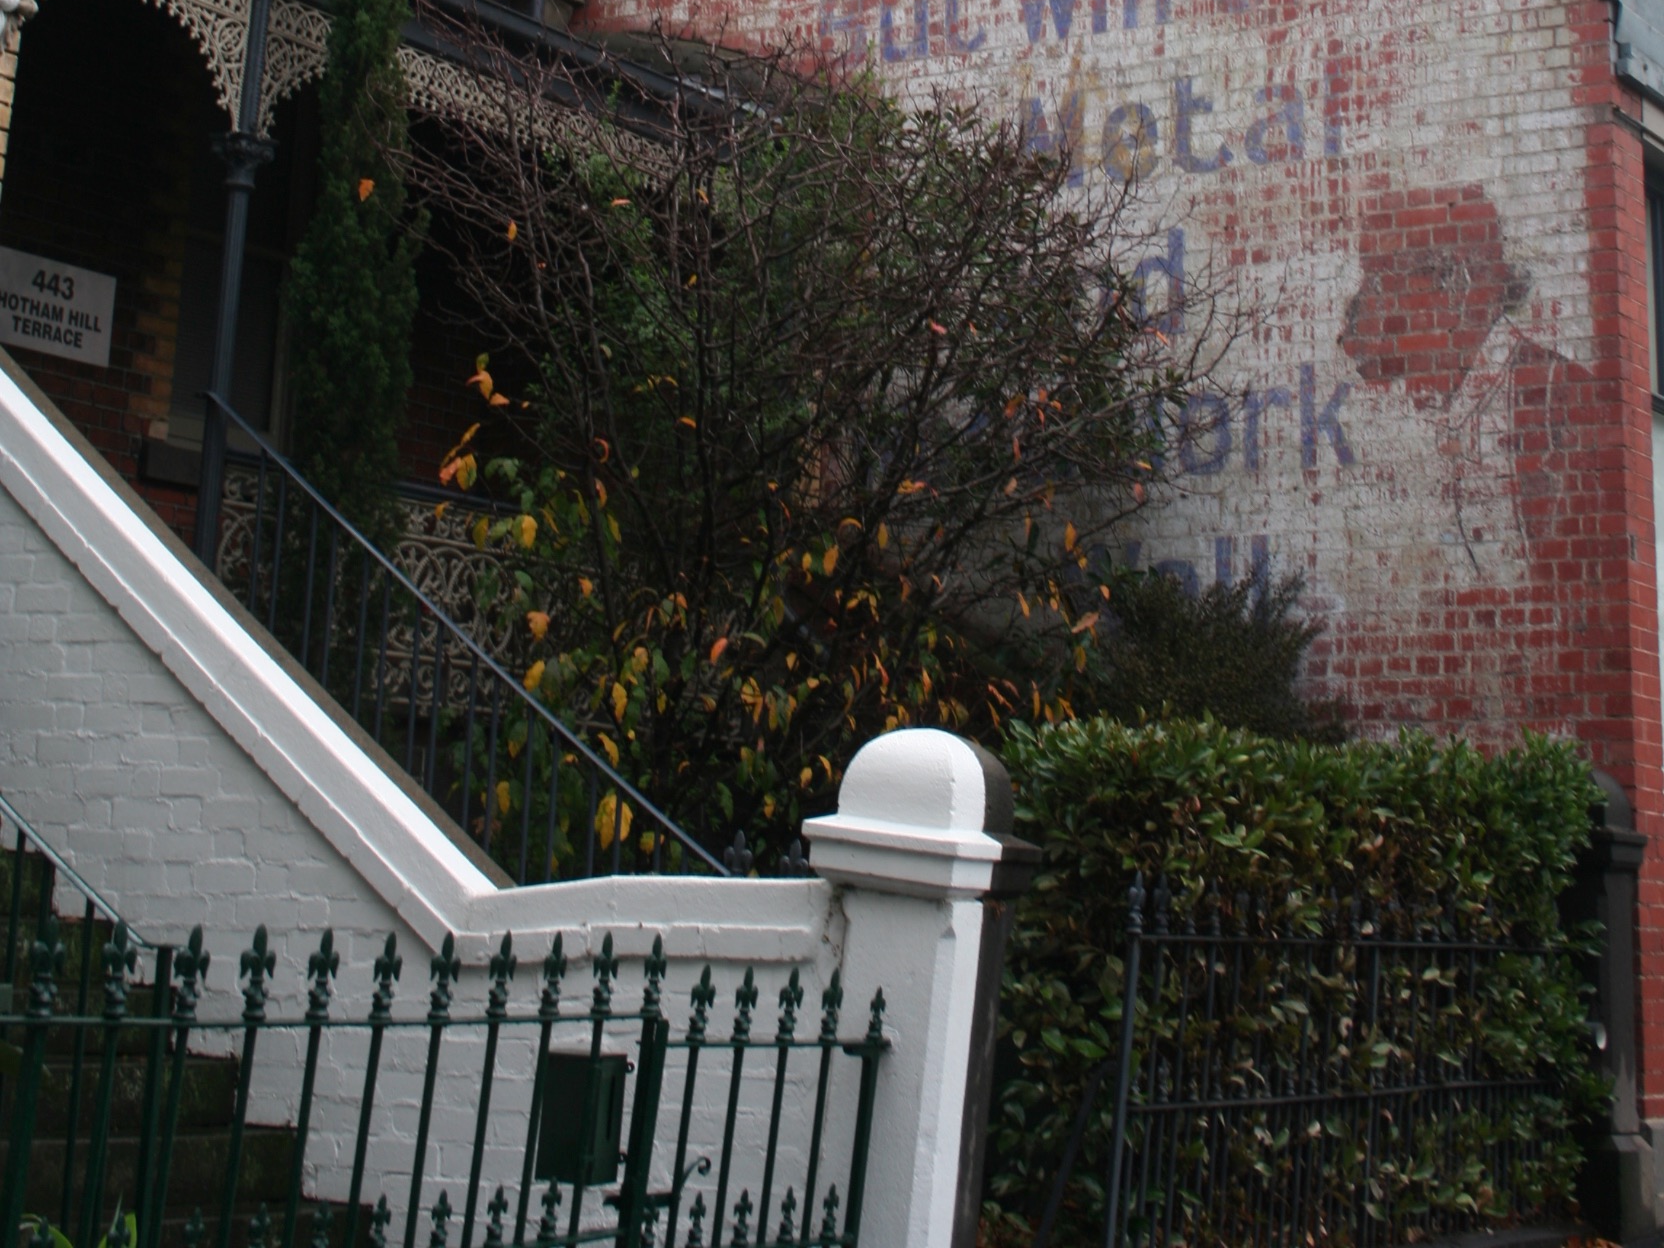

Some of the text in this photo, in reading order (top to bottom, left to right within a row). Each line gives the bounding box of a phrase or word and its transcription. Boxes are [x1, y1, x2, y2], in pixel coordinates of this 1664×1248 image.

[32, 269, 75, 301] 443
[0, 288, 102, 334] HOTHAM HILL
[12, 314, 84, 350] TERRACE
